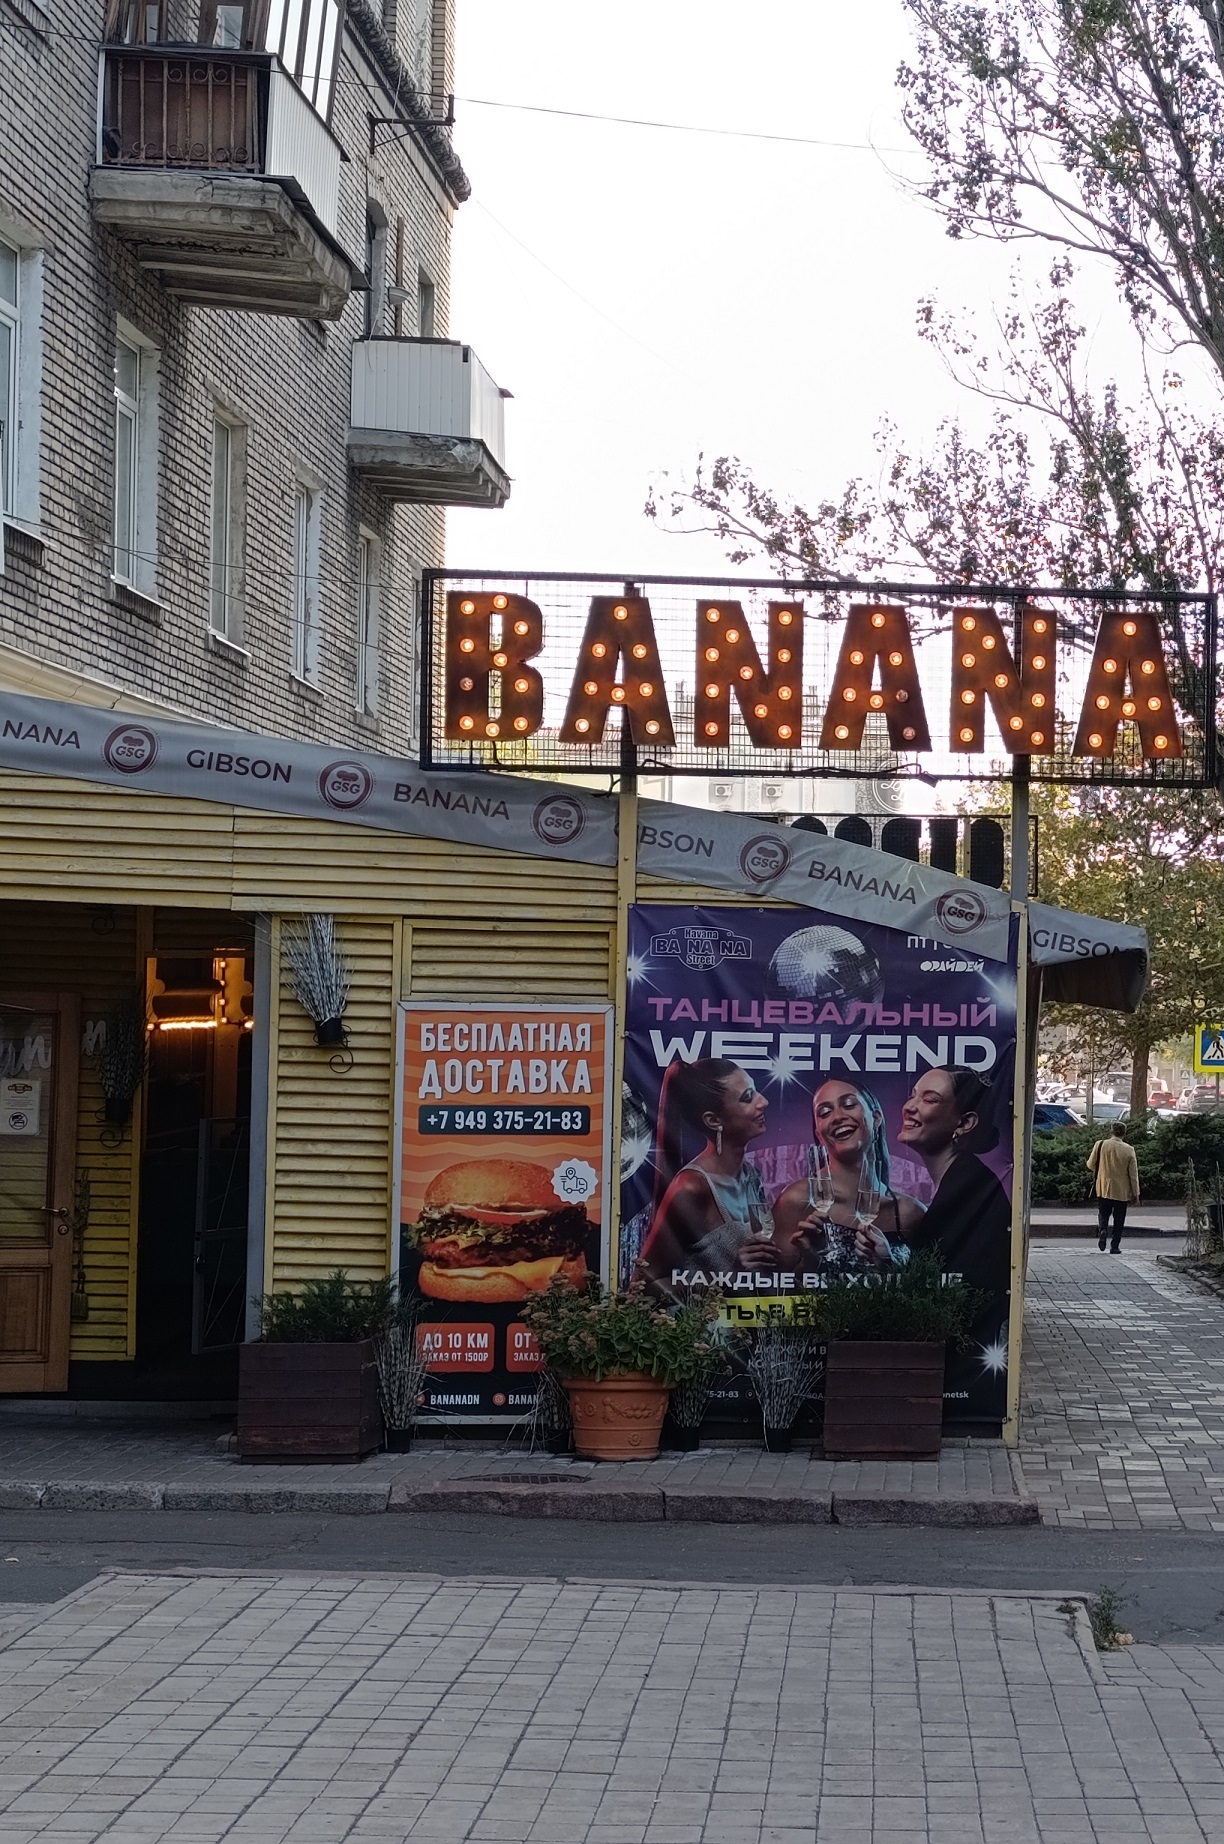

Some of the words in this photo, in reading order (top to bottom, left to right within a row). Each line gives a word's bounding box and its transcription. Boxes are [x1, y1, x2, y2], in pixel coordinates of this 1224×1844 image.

[445, 590, 1183, 758] BANANA
[2, 719, 81, 750] NANA
[115, 745, 145, 759] GSG
[186, 749, 292, 783] GIBSON
[330, 780, 360, 794] GSG
[393, 782, 510, 820] BANANA
[543, 816, 573, 830] GSG
[613, 822, 715, 858] BSON
[750, 856, 779, 870] GSG
[807, 860, 916, 905] BANANA
[947, 905, 975, 922] GSG
[684, 927, 719, 940] Havana
[686, 954, 716, 966] Street
[647, 996, 997, 1028] ТАНЦЕВАЛЬНЫЙ
[420, 1023, 592, 1052] БЕСПЛАТНАЯ
[649, 1029, 998, 1073] WEEKEND
[418, 1058, 592, 1100] ДОСТАВКА
[427, 1111, 449, 1130] +7
[454, 1110, 487, 1130] 949
[493, 1110, 582, 1130] 375-21-83
[671, 1268, 796, 1291] КАЖДЫЕ
[423, 1332, 442, 1351] ДО
[447, 1332, 462, 1348] 10
[467, 1332, 488, 1349] КМ
[514, 1332, 532, 1349] ОТ
[422, 1352, 449, 1362] ЗАКАЗ
[451, 1352, 462, 1362] ОТ
[513, 1352, 539, 1362] ЗАКАЗ
[430, 1394, 480, 1405] BANANADN
